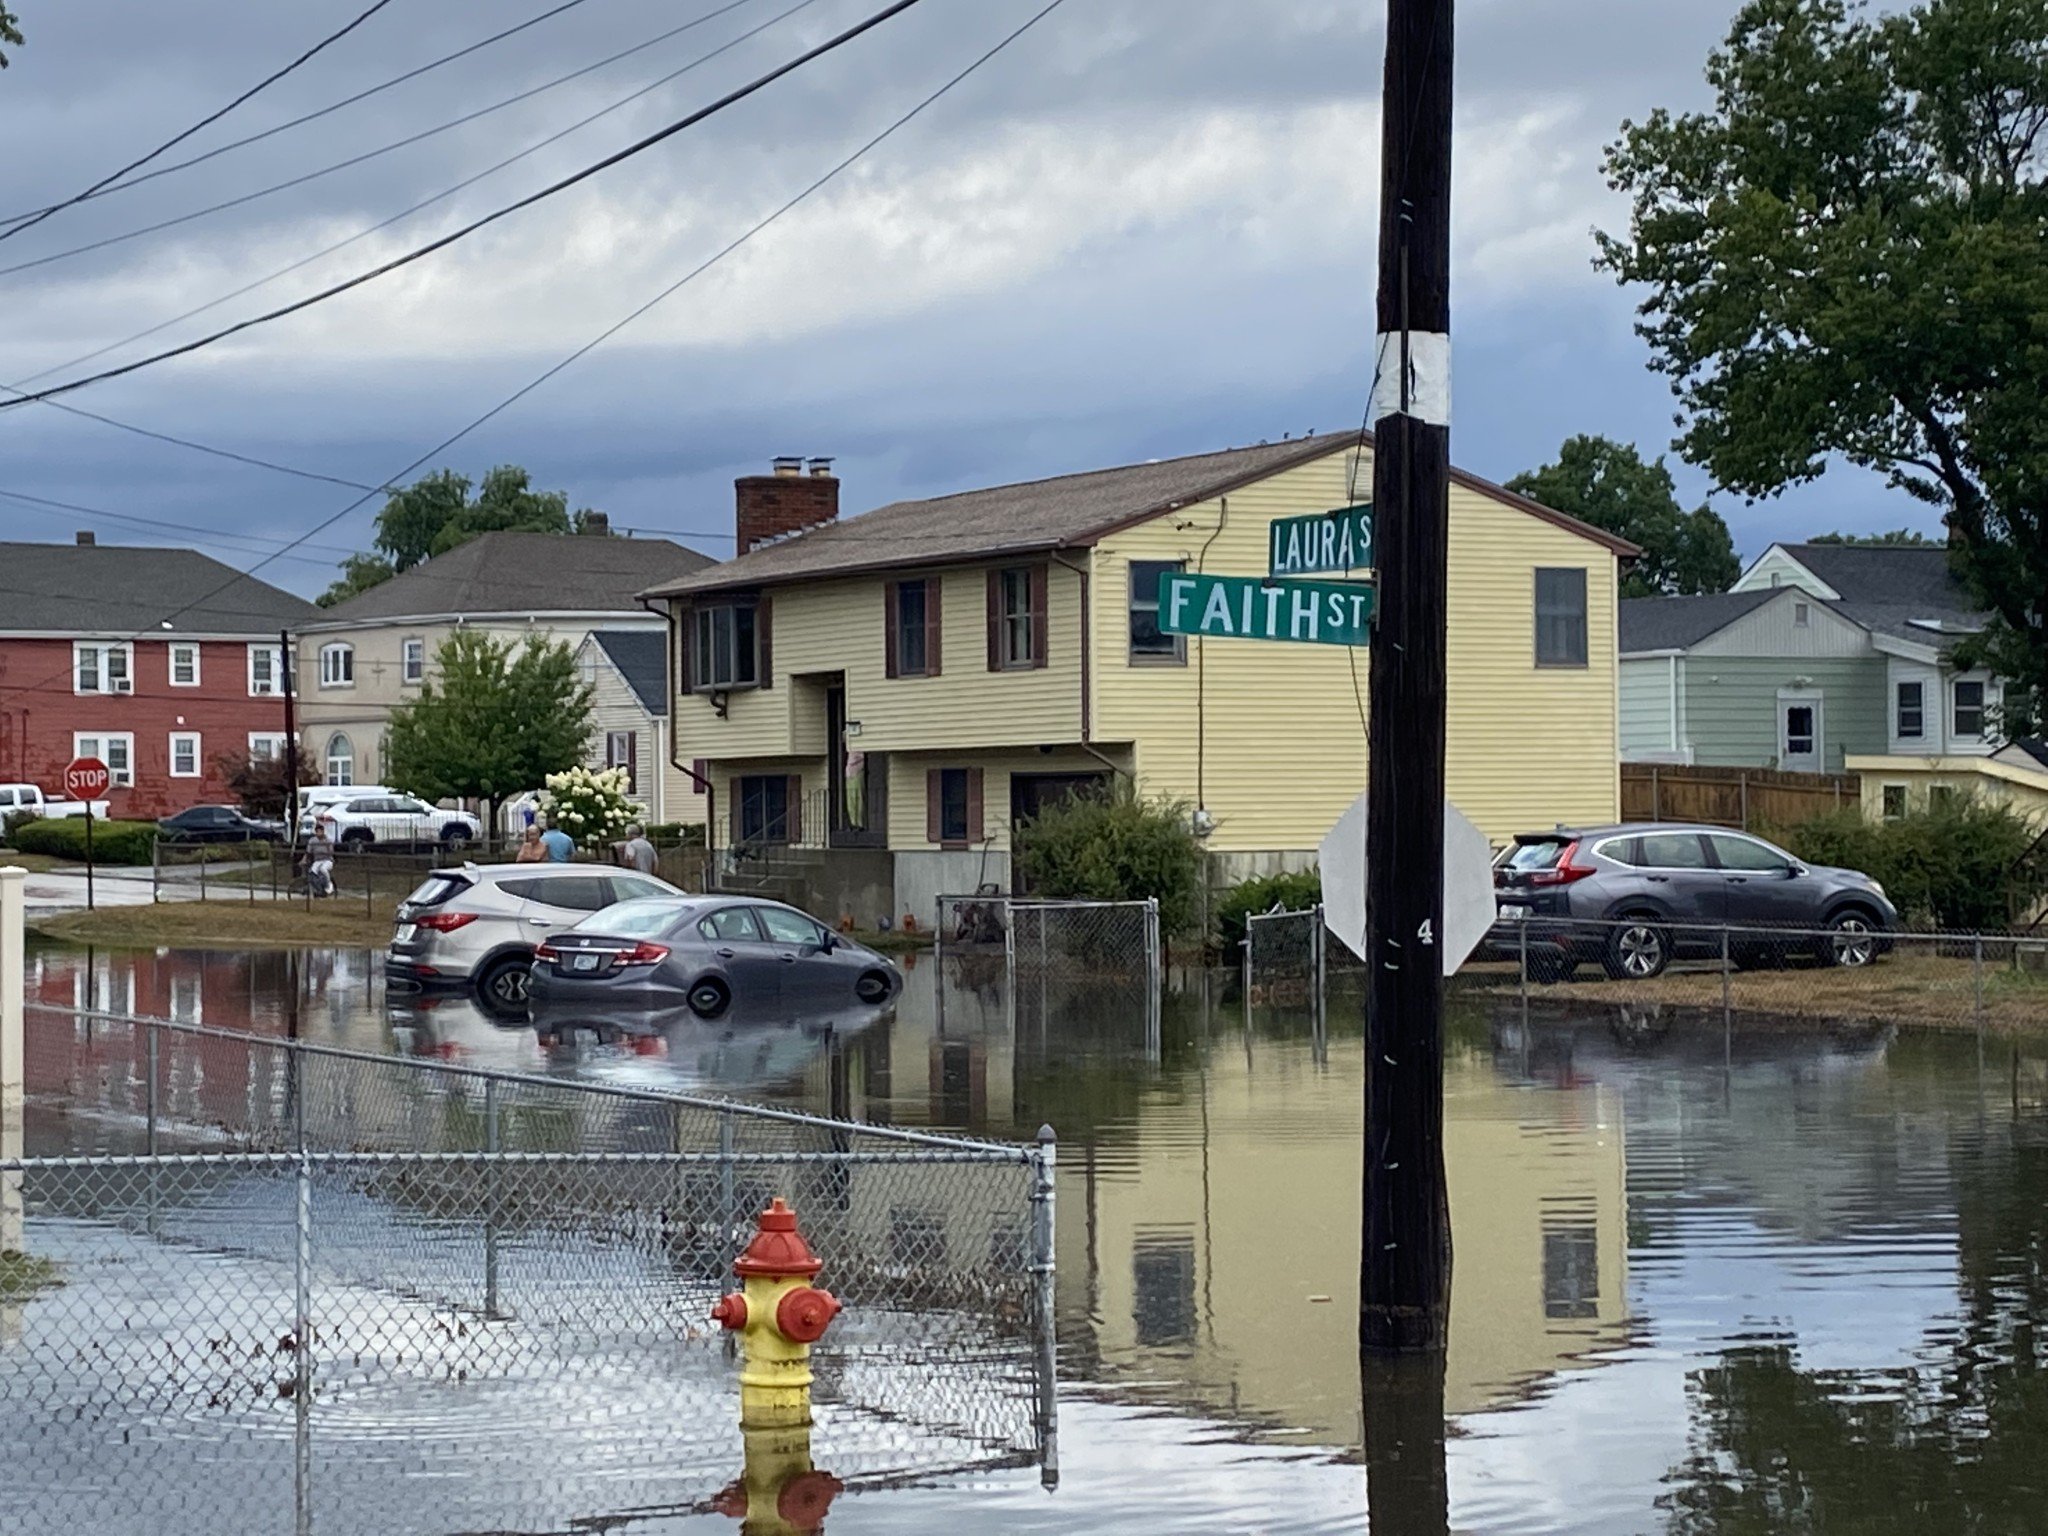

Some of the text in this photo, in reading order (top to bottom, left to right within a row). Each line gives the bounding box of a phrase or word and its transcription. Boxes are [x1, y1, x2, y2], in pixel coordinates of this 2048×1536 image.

[1274, 516, 1355, 571] LAURA
[1169, 578, 1366, 640] FAITH ST
[69, 769, 107, 788] STOP
[1417, 918, 1433, 945] 4
